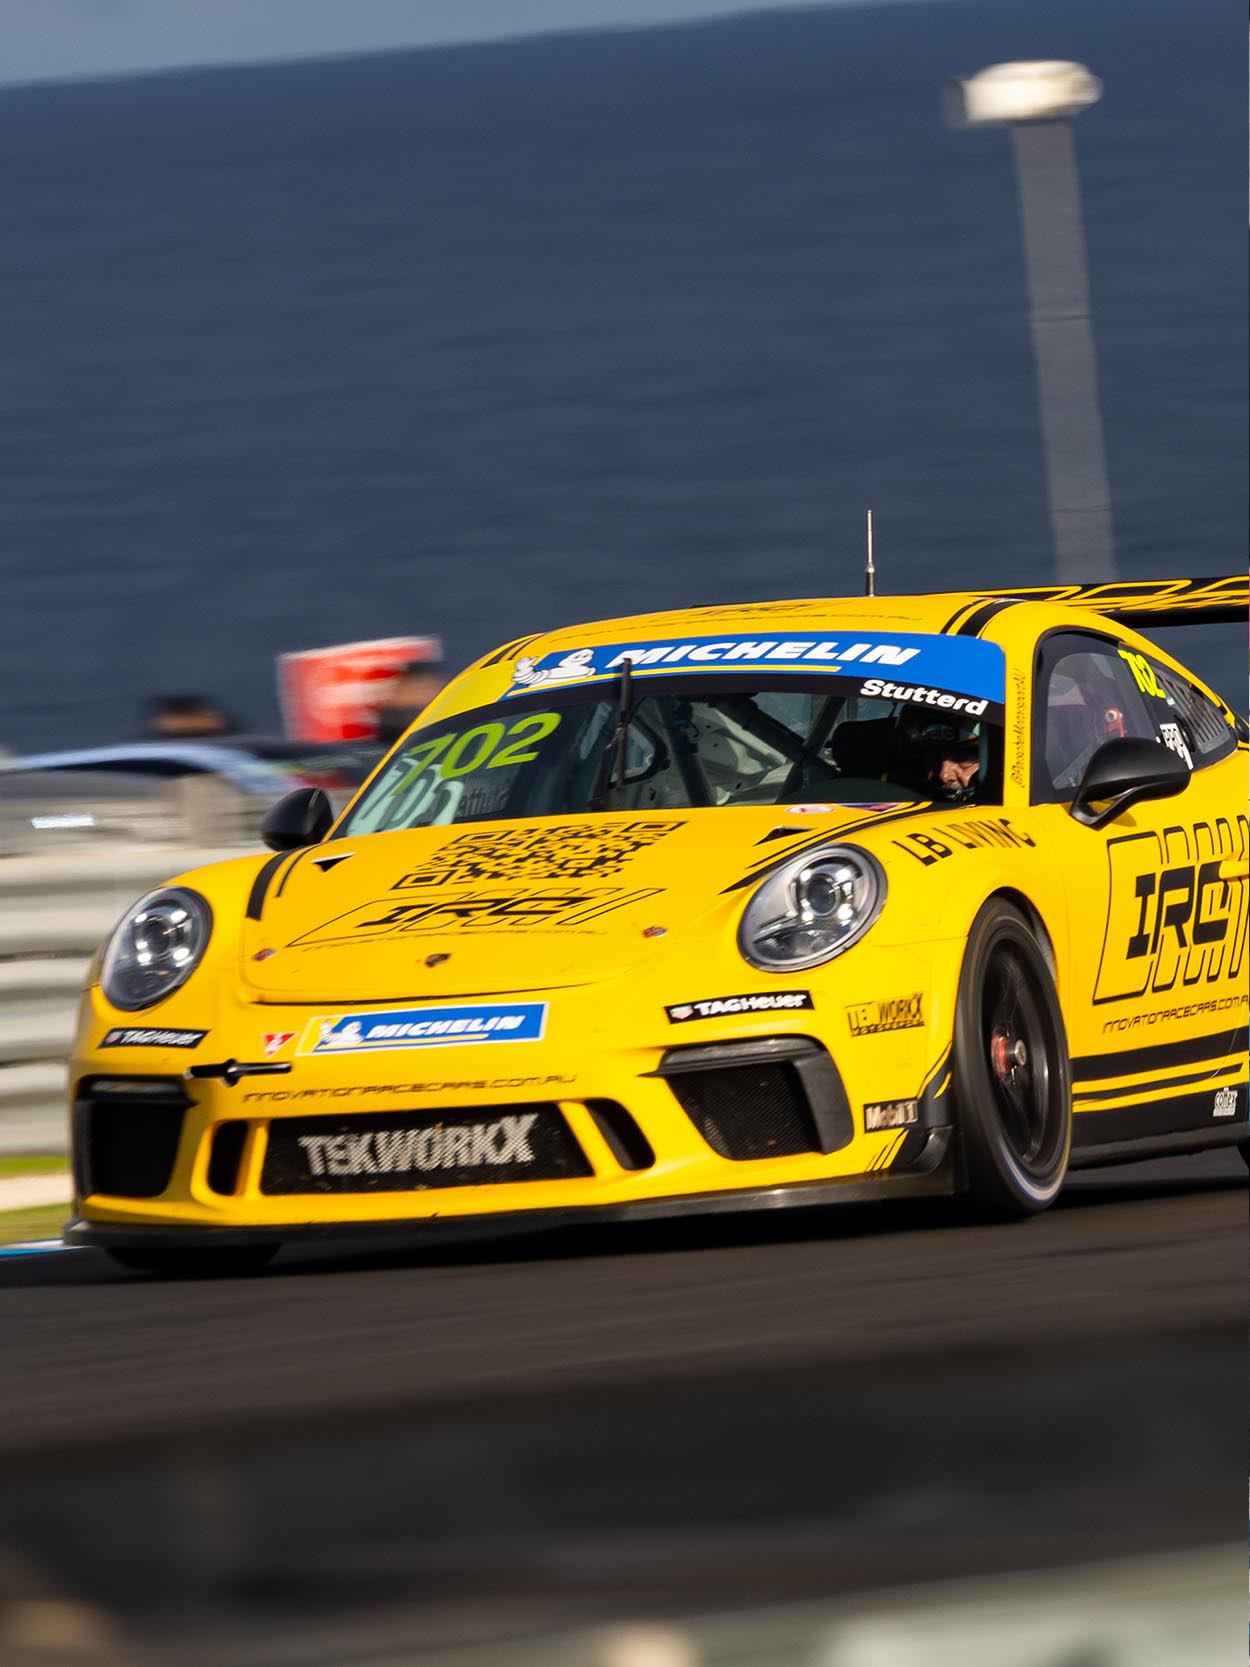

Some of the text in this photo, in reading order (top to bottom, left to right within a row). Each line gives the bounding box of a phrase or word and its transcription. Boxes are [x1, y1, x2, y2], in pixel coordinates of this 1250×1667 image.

[605, 641, 921, 668] MICHELIN
[860, 679, 988, 716] Stutterd
[390, 712, 562, 797] 702
[891, 818, 1037, 867] LB LIVING
[364, 1015, 526, 1039] MICHELIN
[297, 1113, 540, 1177] TEKWORKX
